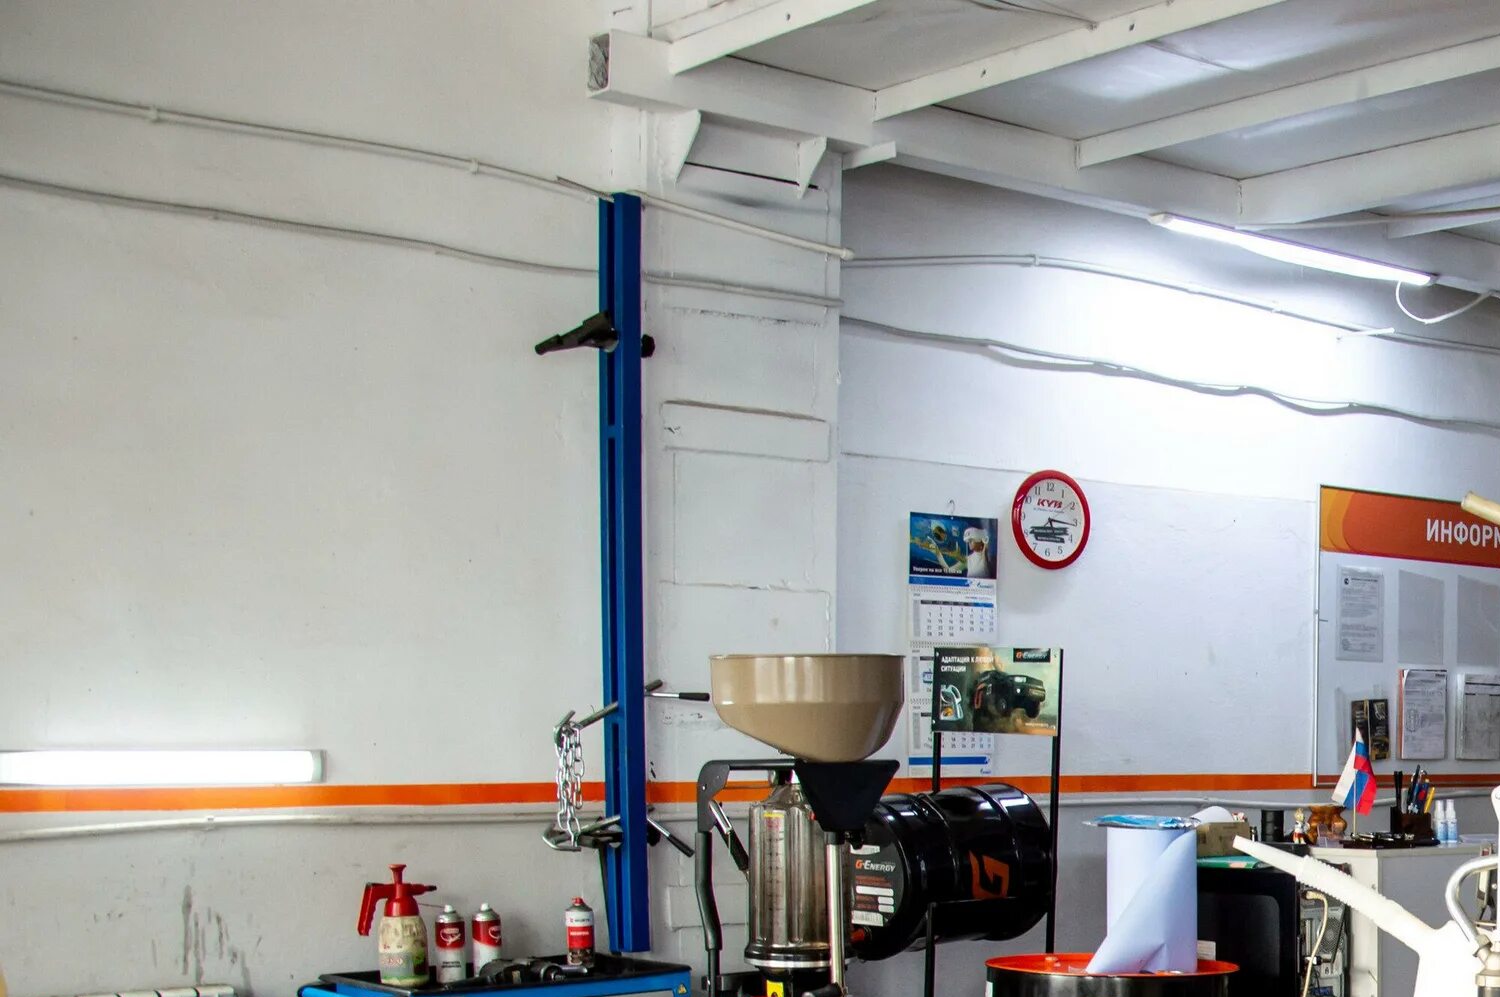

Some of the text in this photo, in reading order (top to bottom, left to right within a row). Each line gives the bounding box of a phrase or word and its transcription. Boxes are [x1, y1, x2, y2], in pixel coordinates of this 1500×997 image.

[1046, 482, 1055, 492] 12
[1037, 499, 1063, 509] KYB
[855, 859, 896, 873] G-ENERGY
